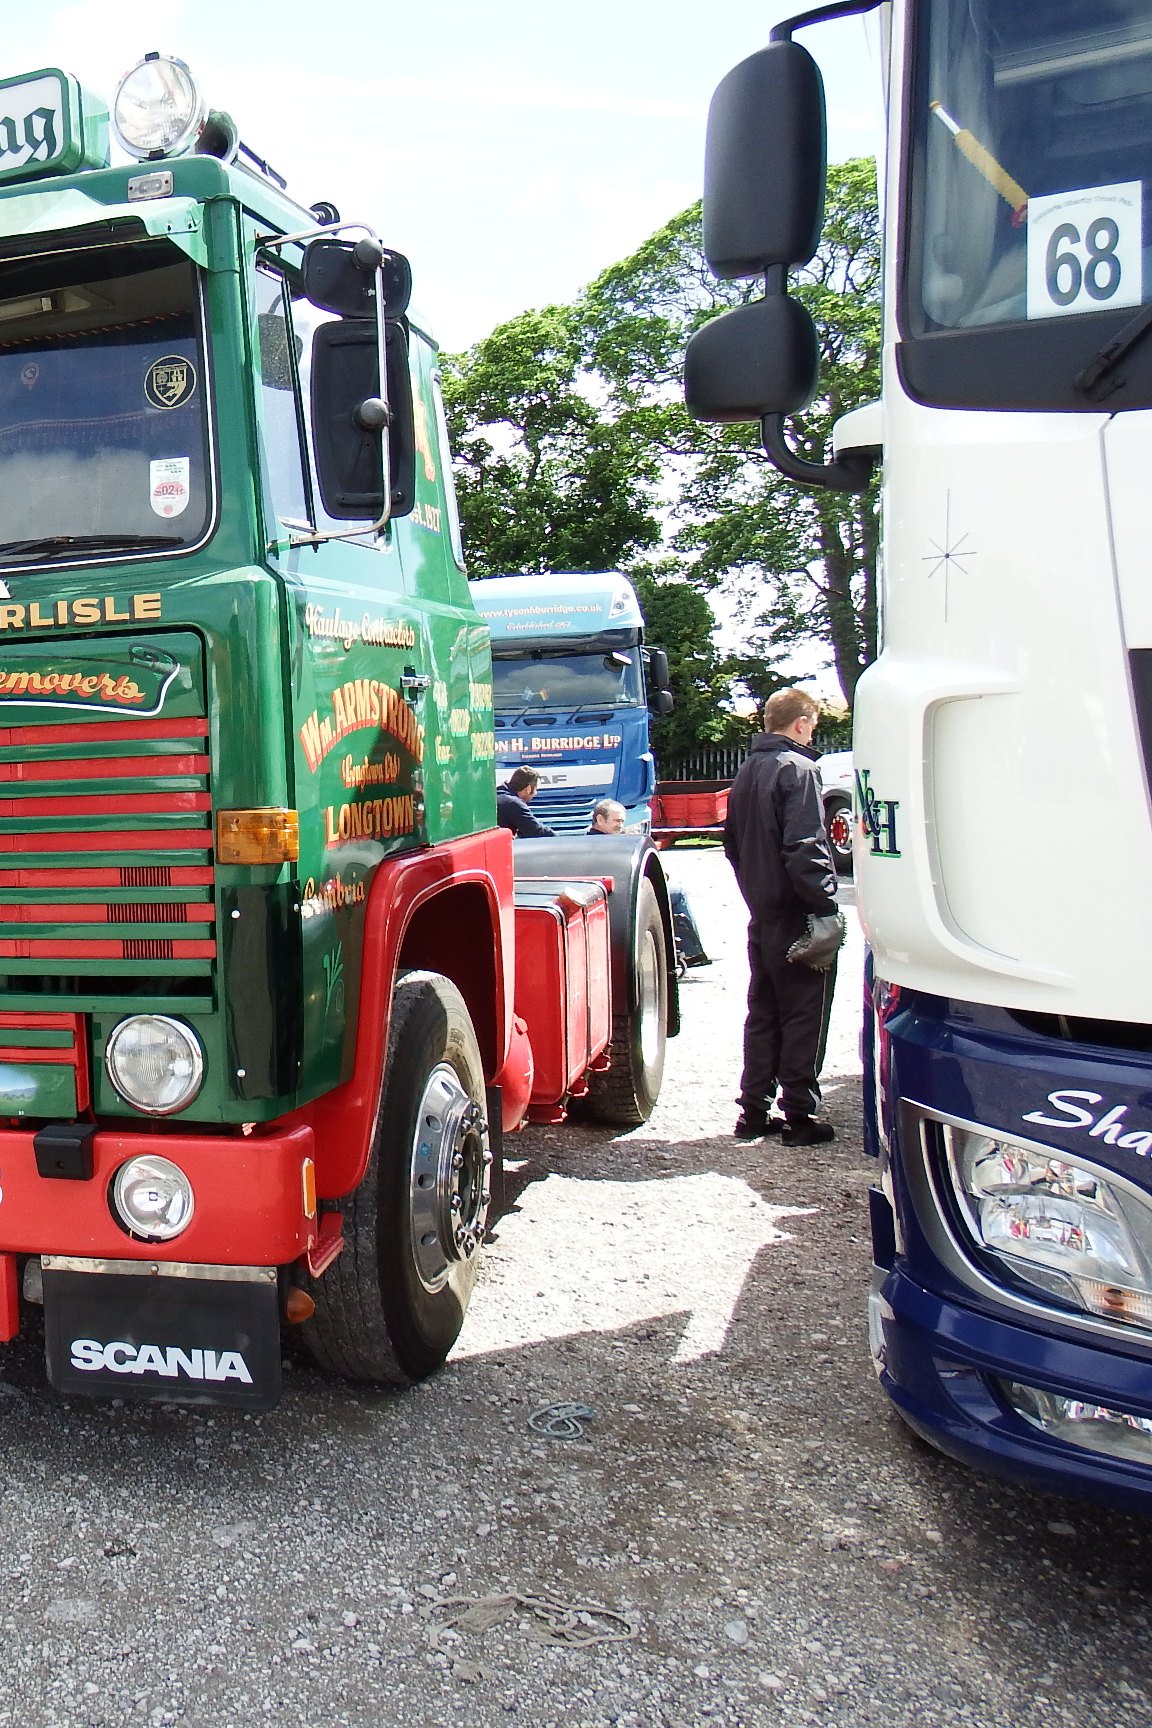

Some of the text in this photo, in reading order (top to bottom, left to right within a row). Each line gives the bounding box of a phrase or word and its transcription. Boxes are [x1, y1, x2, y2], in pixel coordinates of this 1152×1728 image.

[1046, 217, 1121, 306] 68
[333, 679, 425, 765] ARMSTRONG
[531, 735, 600, 752] BURRIDGE
[326, 794, 415, 850] LONGTOWN
[1022, 1089, 1152, 1159] Sha
[70, 1338, 254, 1384] SCANIA
